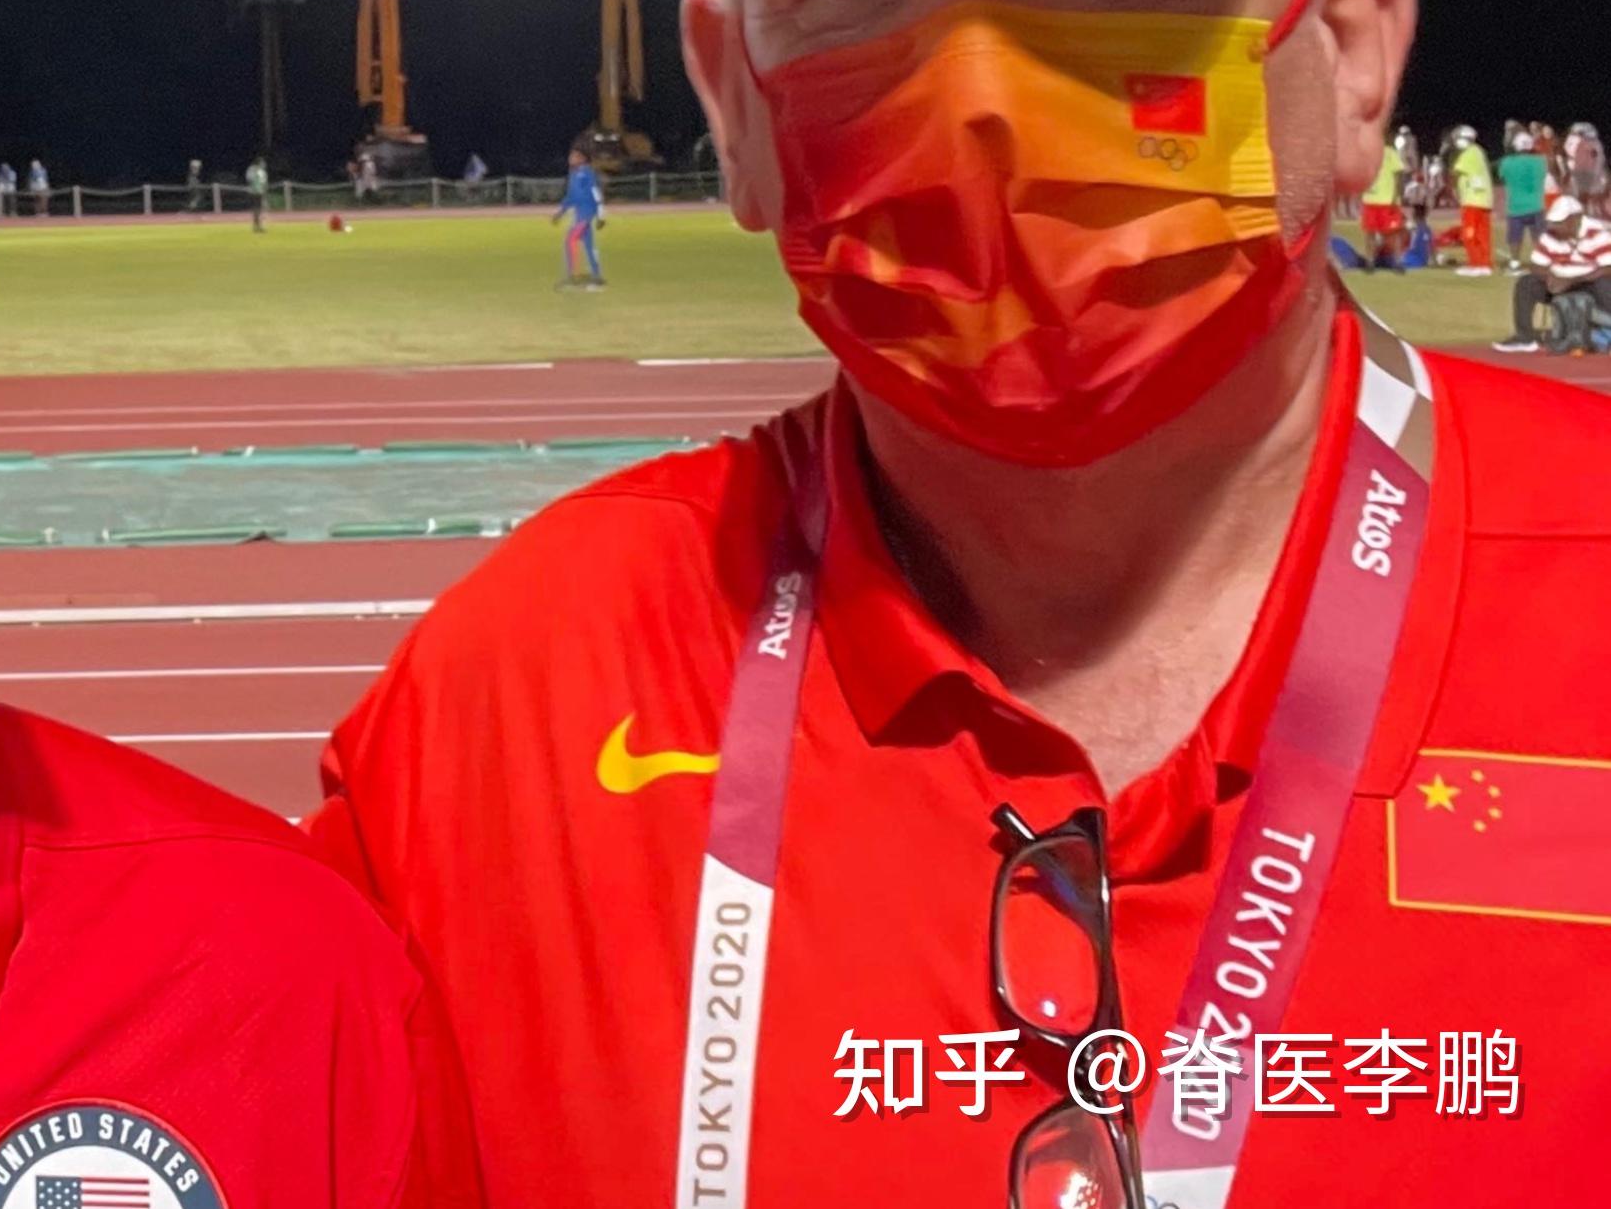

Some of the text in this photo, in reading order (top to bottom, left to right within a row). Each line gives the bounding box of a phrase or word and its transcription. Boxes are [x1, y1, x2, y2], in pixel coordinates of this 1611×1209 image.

[1351, 469, 1407, 577] Atos
[758, 571, 802, 660] Atos
[1215, 827, 1316, 1000] TOKYO
[693, 901, 752, 1207] TOKYO 2020
[98, 1113, 199, 1193] STATES
